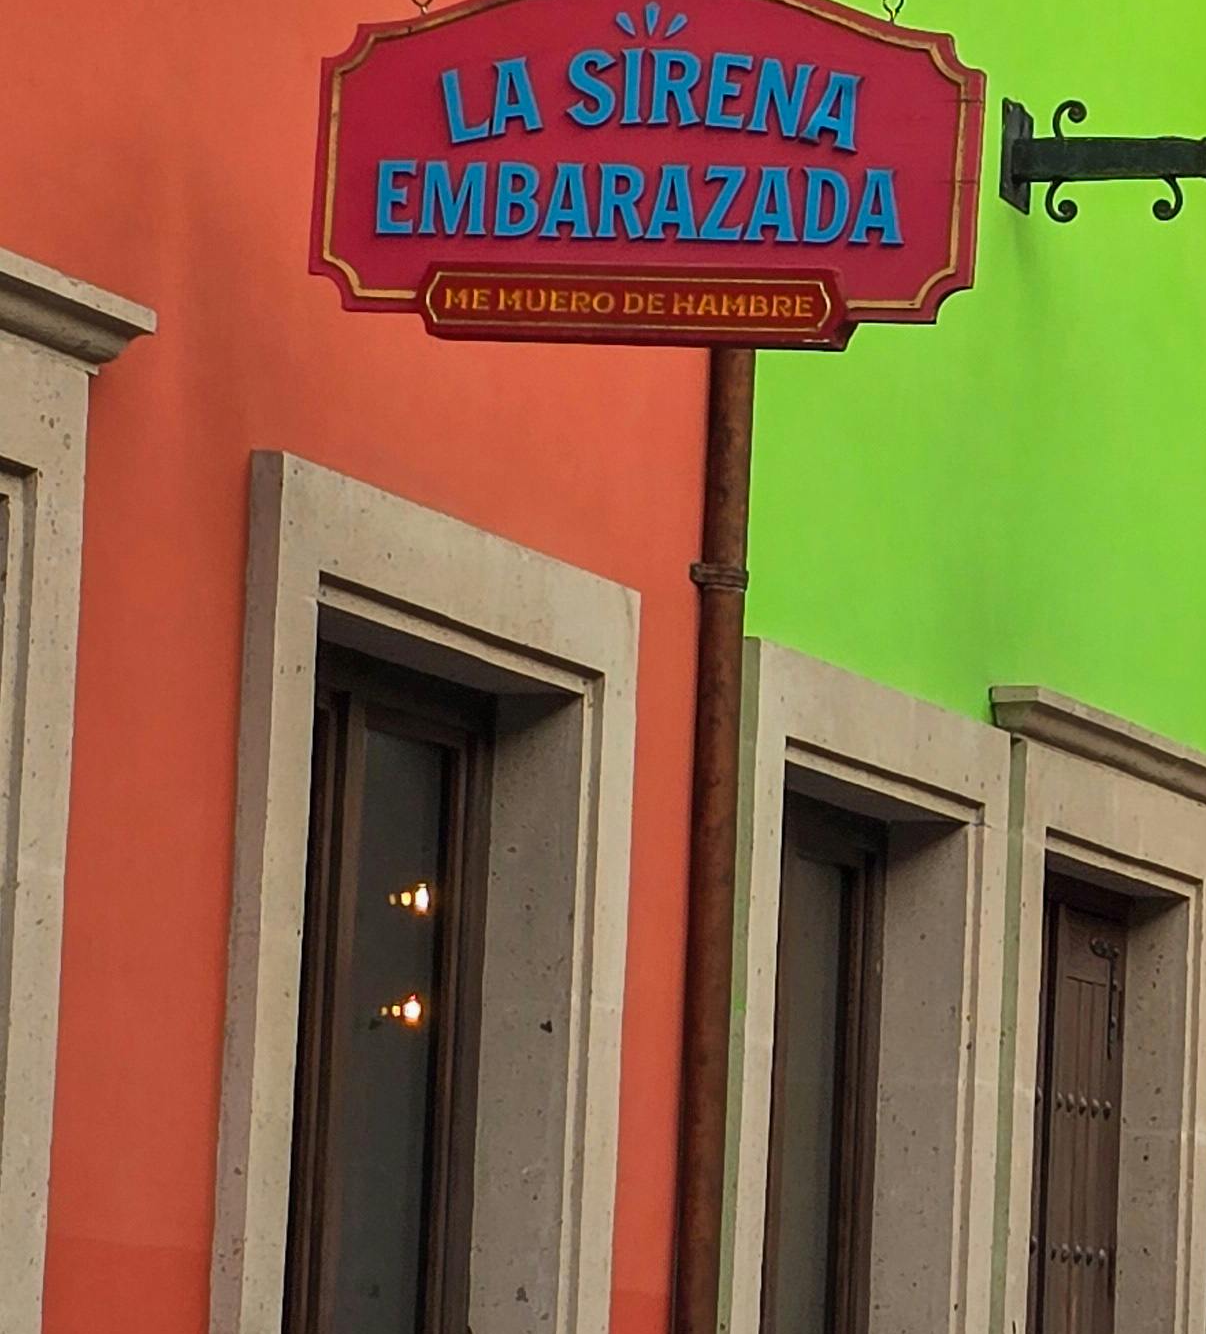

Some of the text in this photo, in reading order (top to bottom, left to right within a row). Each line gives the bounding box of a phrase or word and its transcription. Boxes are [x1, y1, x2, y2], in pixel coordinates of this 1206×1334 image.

[440, 48, 863, 152] LA SIRENA
[375, 158, 905, 247] EMBARAZADA
[444, 287, 814, 319] ME MUERO DE HAMBRE
